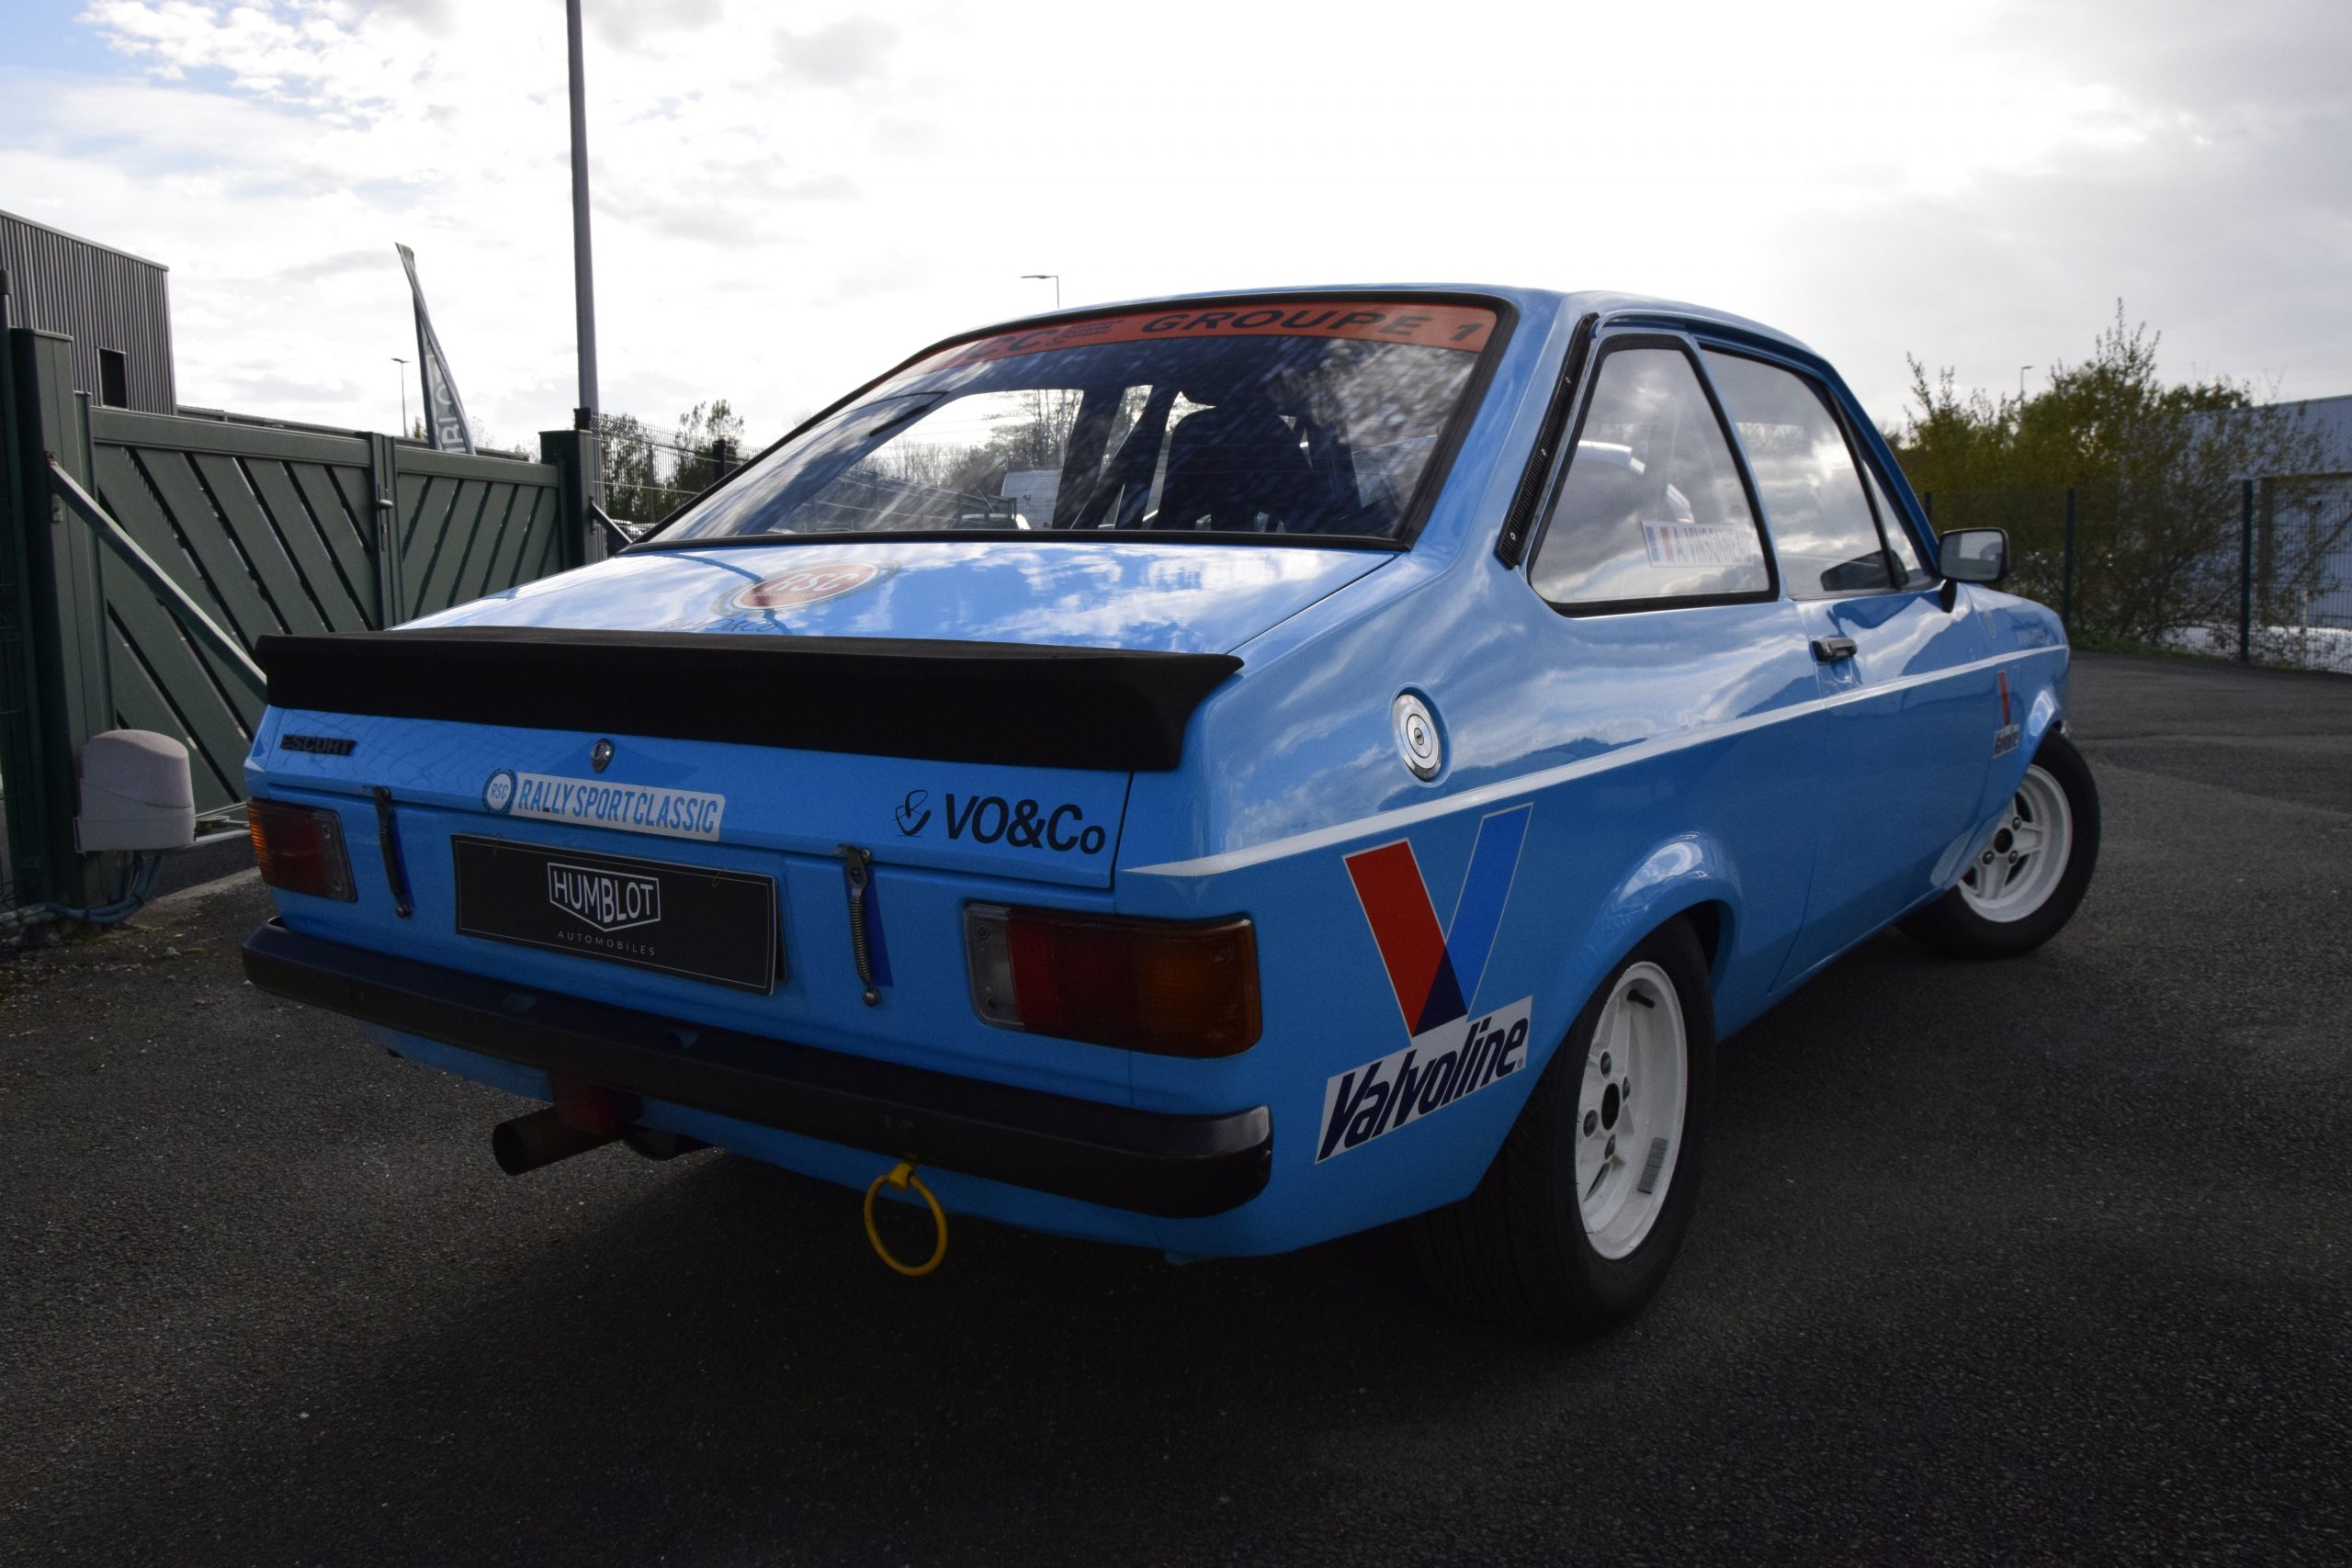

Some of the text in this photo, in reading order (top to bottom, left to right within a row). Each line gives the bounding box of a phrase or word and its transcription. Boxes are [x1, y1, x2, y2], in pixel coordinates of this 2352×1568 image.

[1141, 310, 1433, 336] GROUPE
[1448, 321, 1485, 343] 1
[763, 572, 860, 592] RSC
[280, 734, 356, 756] ESCORT
[489, 782, 509, 799] RSC
[945, 793, 1106, 855] VO&Co
[553, 870, 654, 923] HUMBLOT
[558, 930, 655, 956] AUTOMOBILES
[1317, 1016, 1529, 1162] Valvoline
